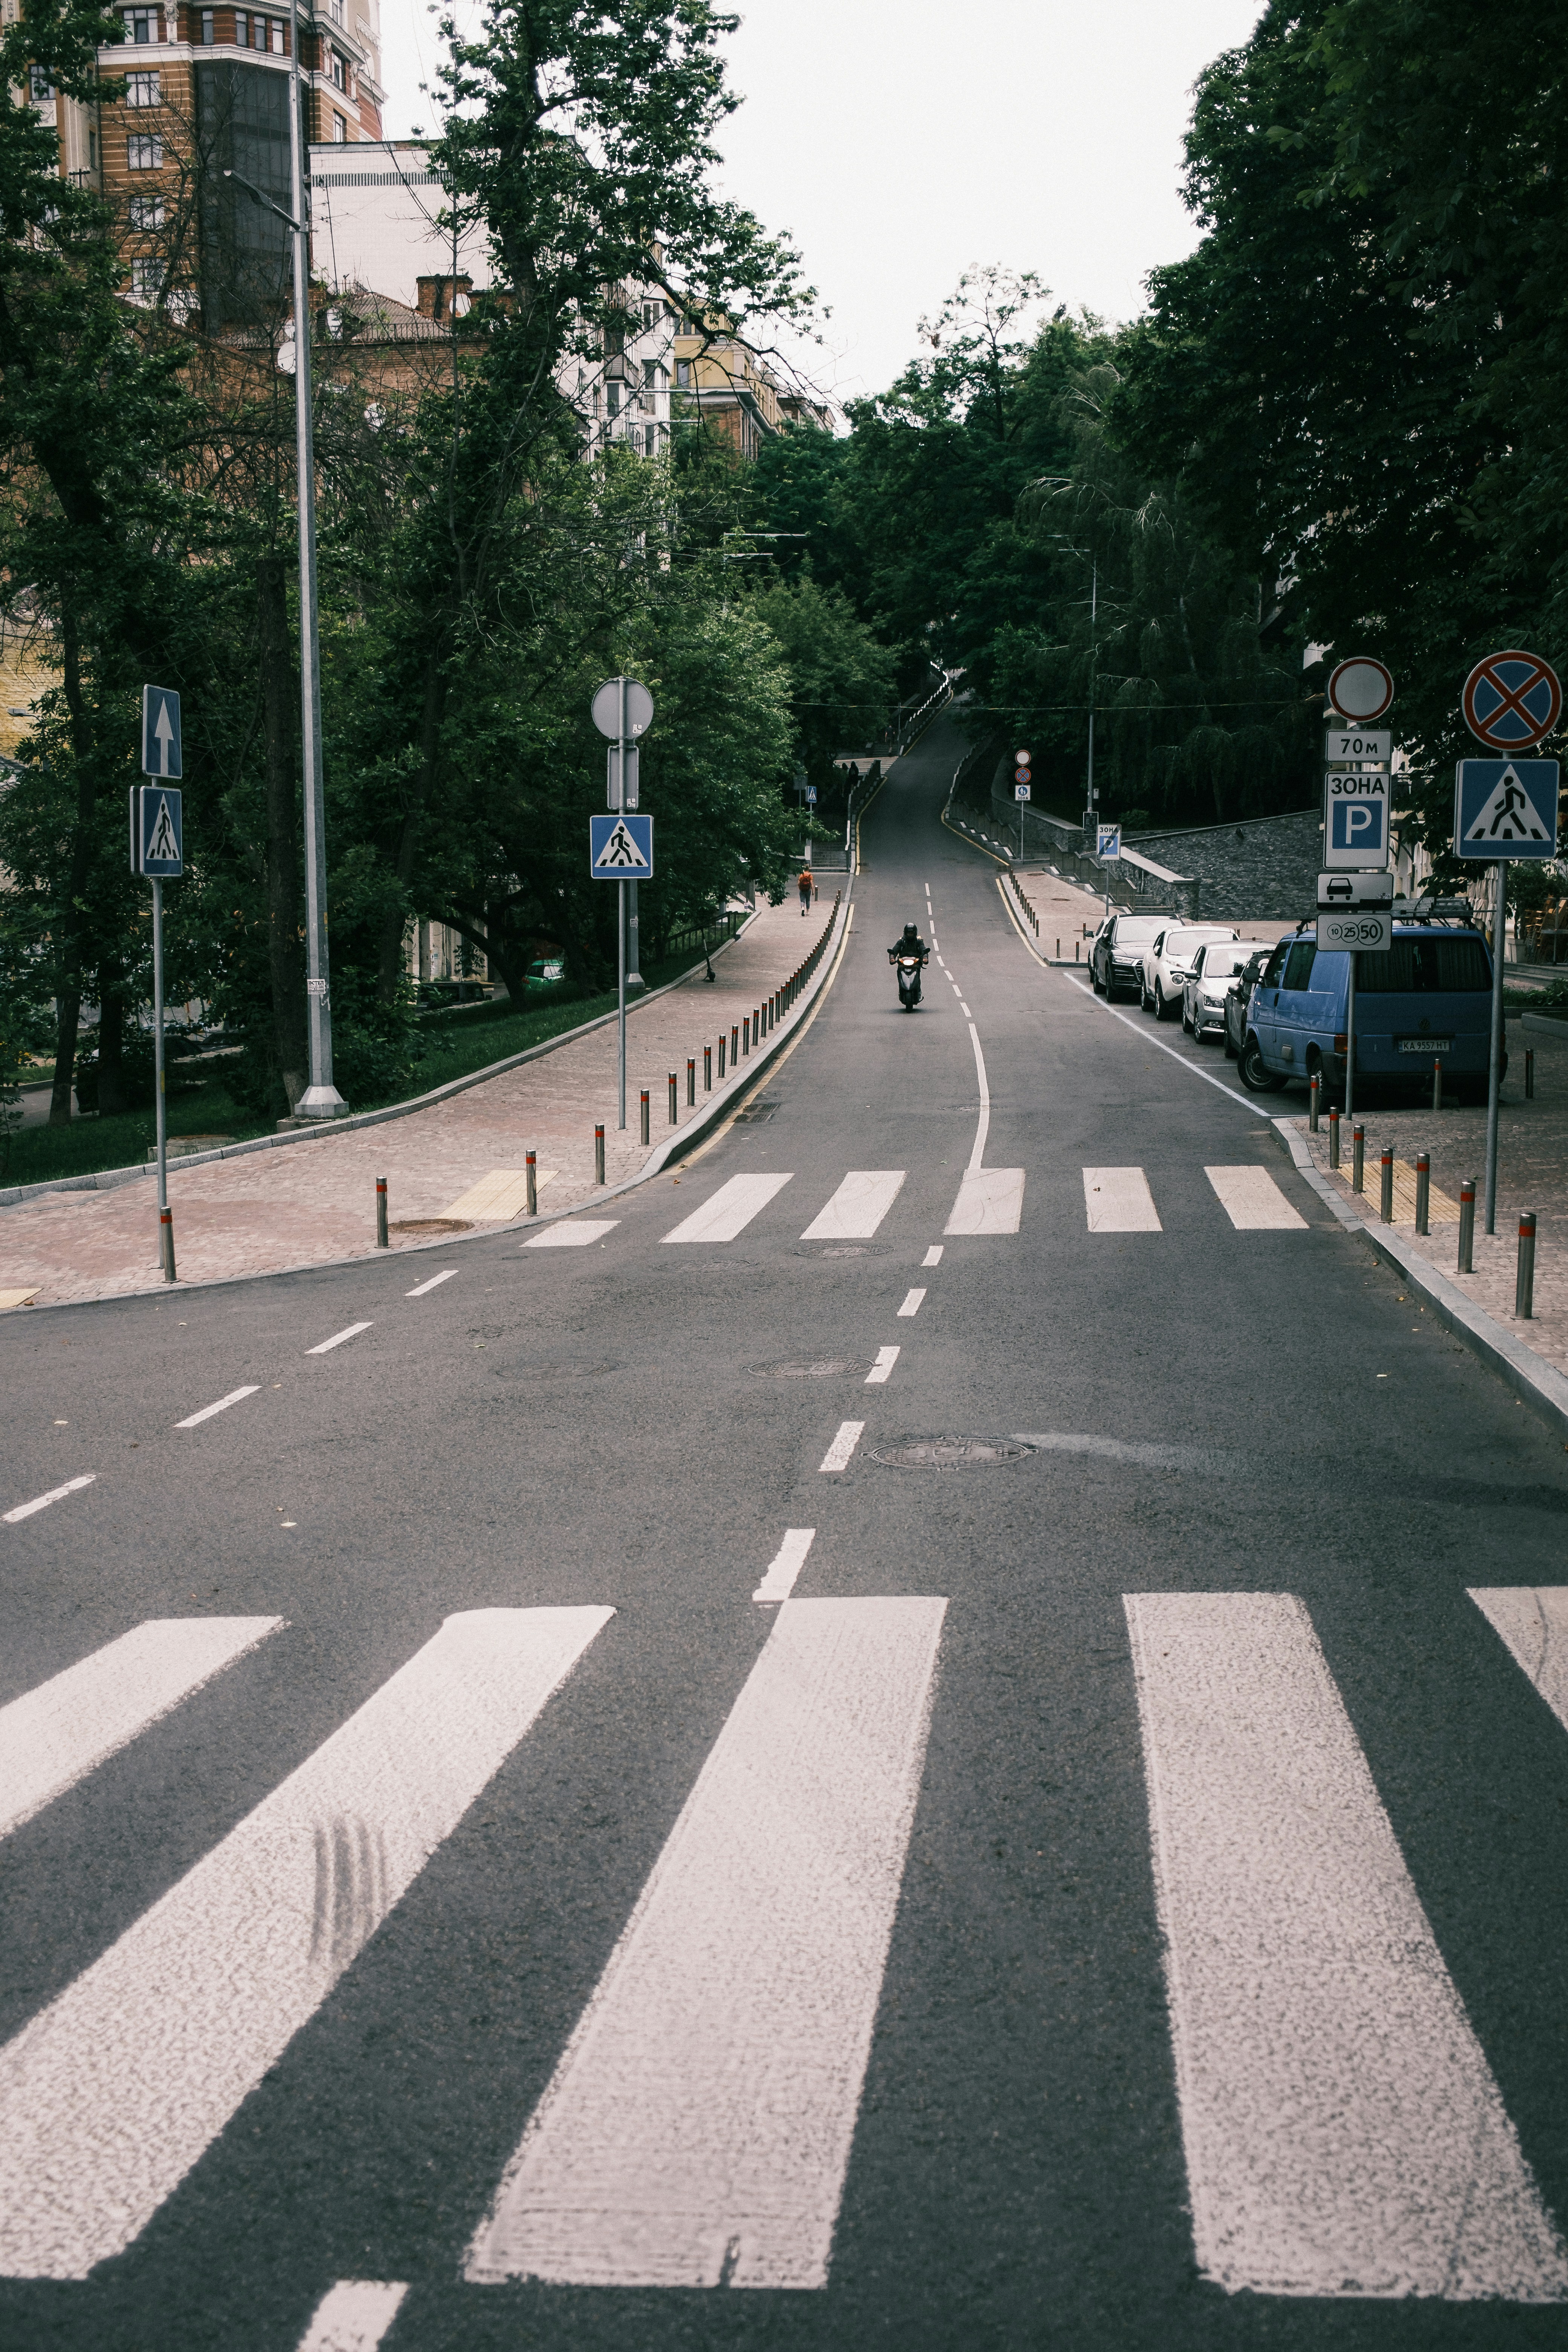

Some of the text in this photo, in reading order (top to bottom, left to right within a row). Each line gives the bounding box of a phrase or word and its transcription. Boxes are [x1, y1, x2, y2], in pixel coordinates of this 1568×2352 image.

[1331, 777, 1385, 794] ЗОНА
[1346, 806, 1372, 844] P
[1344, 927, 1356, 937] 25
[1360, 924, 1378, 939] 50
